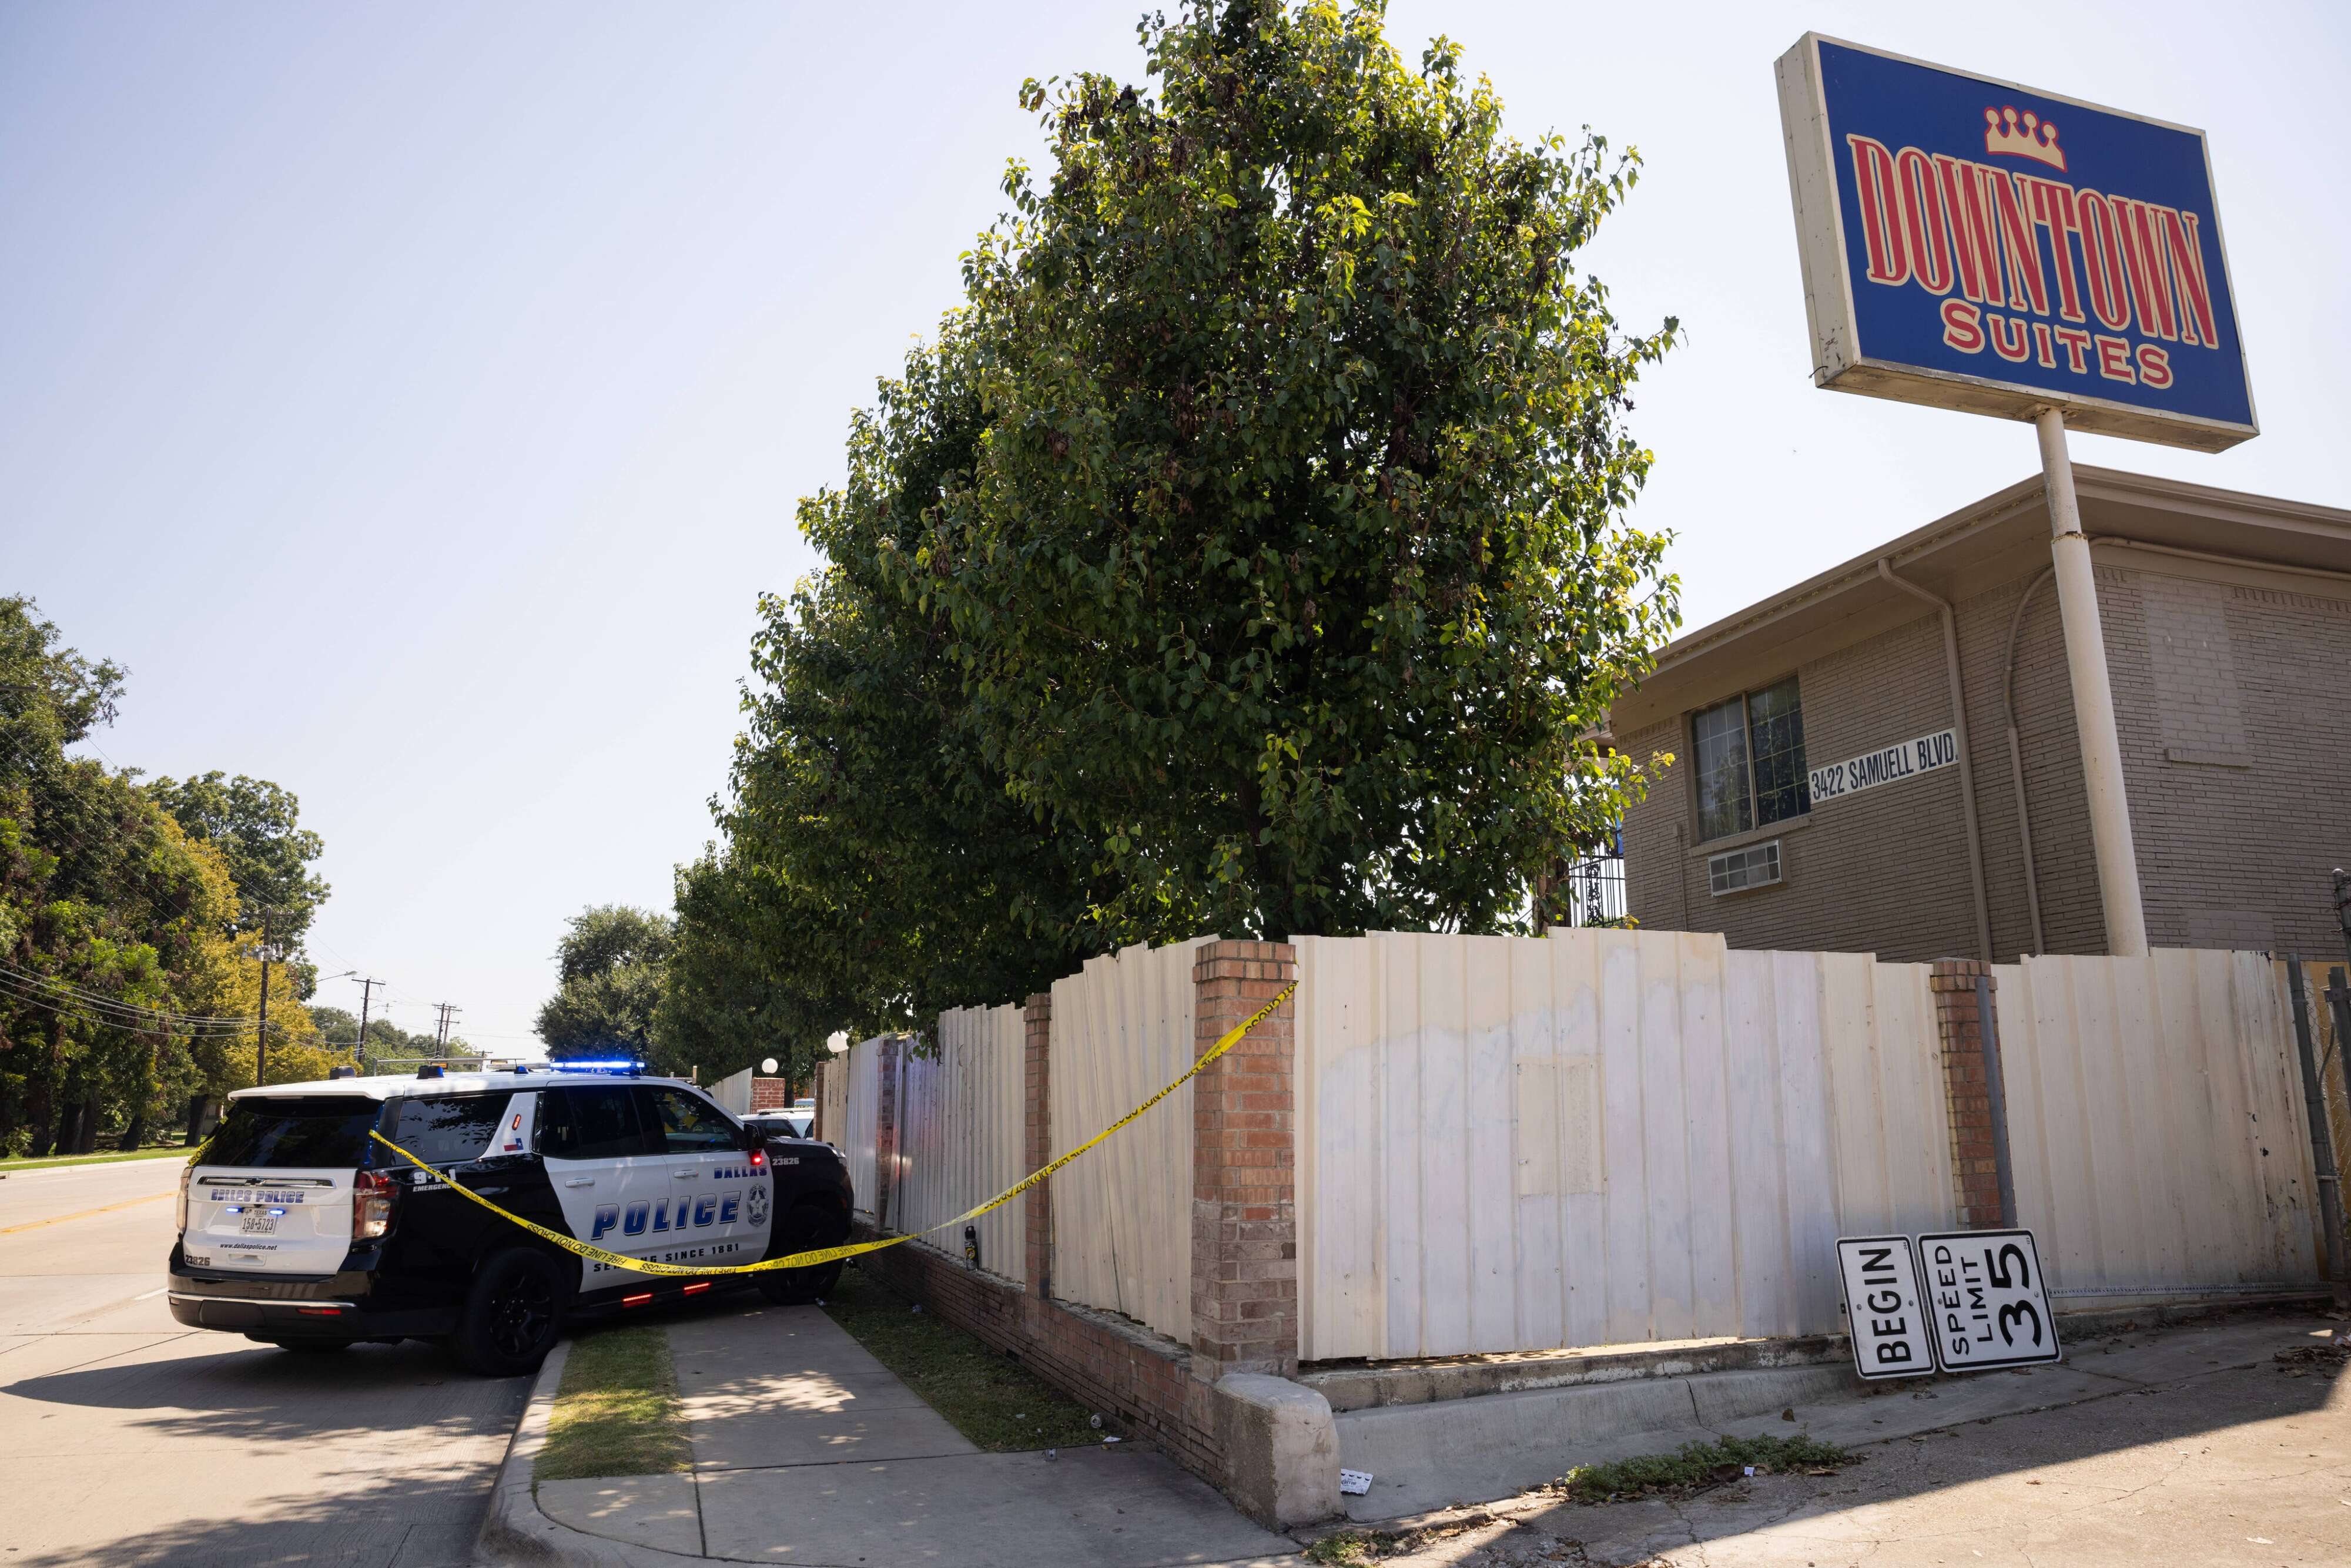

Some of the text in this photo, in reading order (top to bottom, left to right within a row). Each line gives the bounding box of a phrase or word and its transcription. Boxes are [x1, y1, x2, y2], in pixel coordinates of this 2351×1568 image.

[1846, 133, 2219, 350] DOWNTOWN
[1940, 298, 2173, 390] SUITES
[1811, 765, 1845, 800] 3422
[1848, 745, 1914, 789] SAMUELL
[714, 1165, 767, 1178] DALLAS
[772, 1157, 799, 1165] 23826
[211, 1189, 304, 1204] DALLAS POLICE
[413, 1184, 451, 1192] EMERGENC
[590, 1191, 741, 1241] POLICE
[185, 1254, 210, 1266] 23826
[220, 1242, 277, 1251] www.dallaspolice.net
[527, 1224, 628, 1265] FIRE LINE DO NOT CROSS
[594, 1243, 739, 1272] SENG SINCE 1881
[639, 1263, 669, 1273] CROSS
[1858, 1248, 1913, 1364] BEGIN
[1934, 1245, 1970, 1356] SPEED
[1961, 1257, 1994, 1342] LIMIT
[1984, 1243, 2042, 1348] 35
